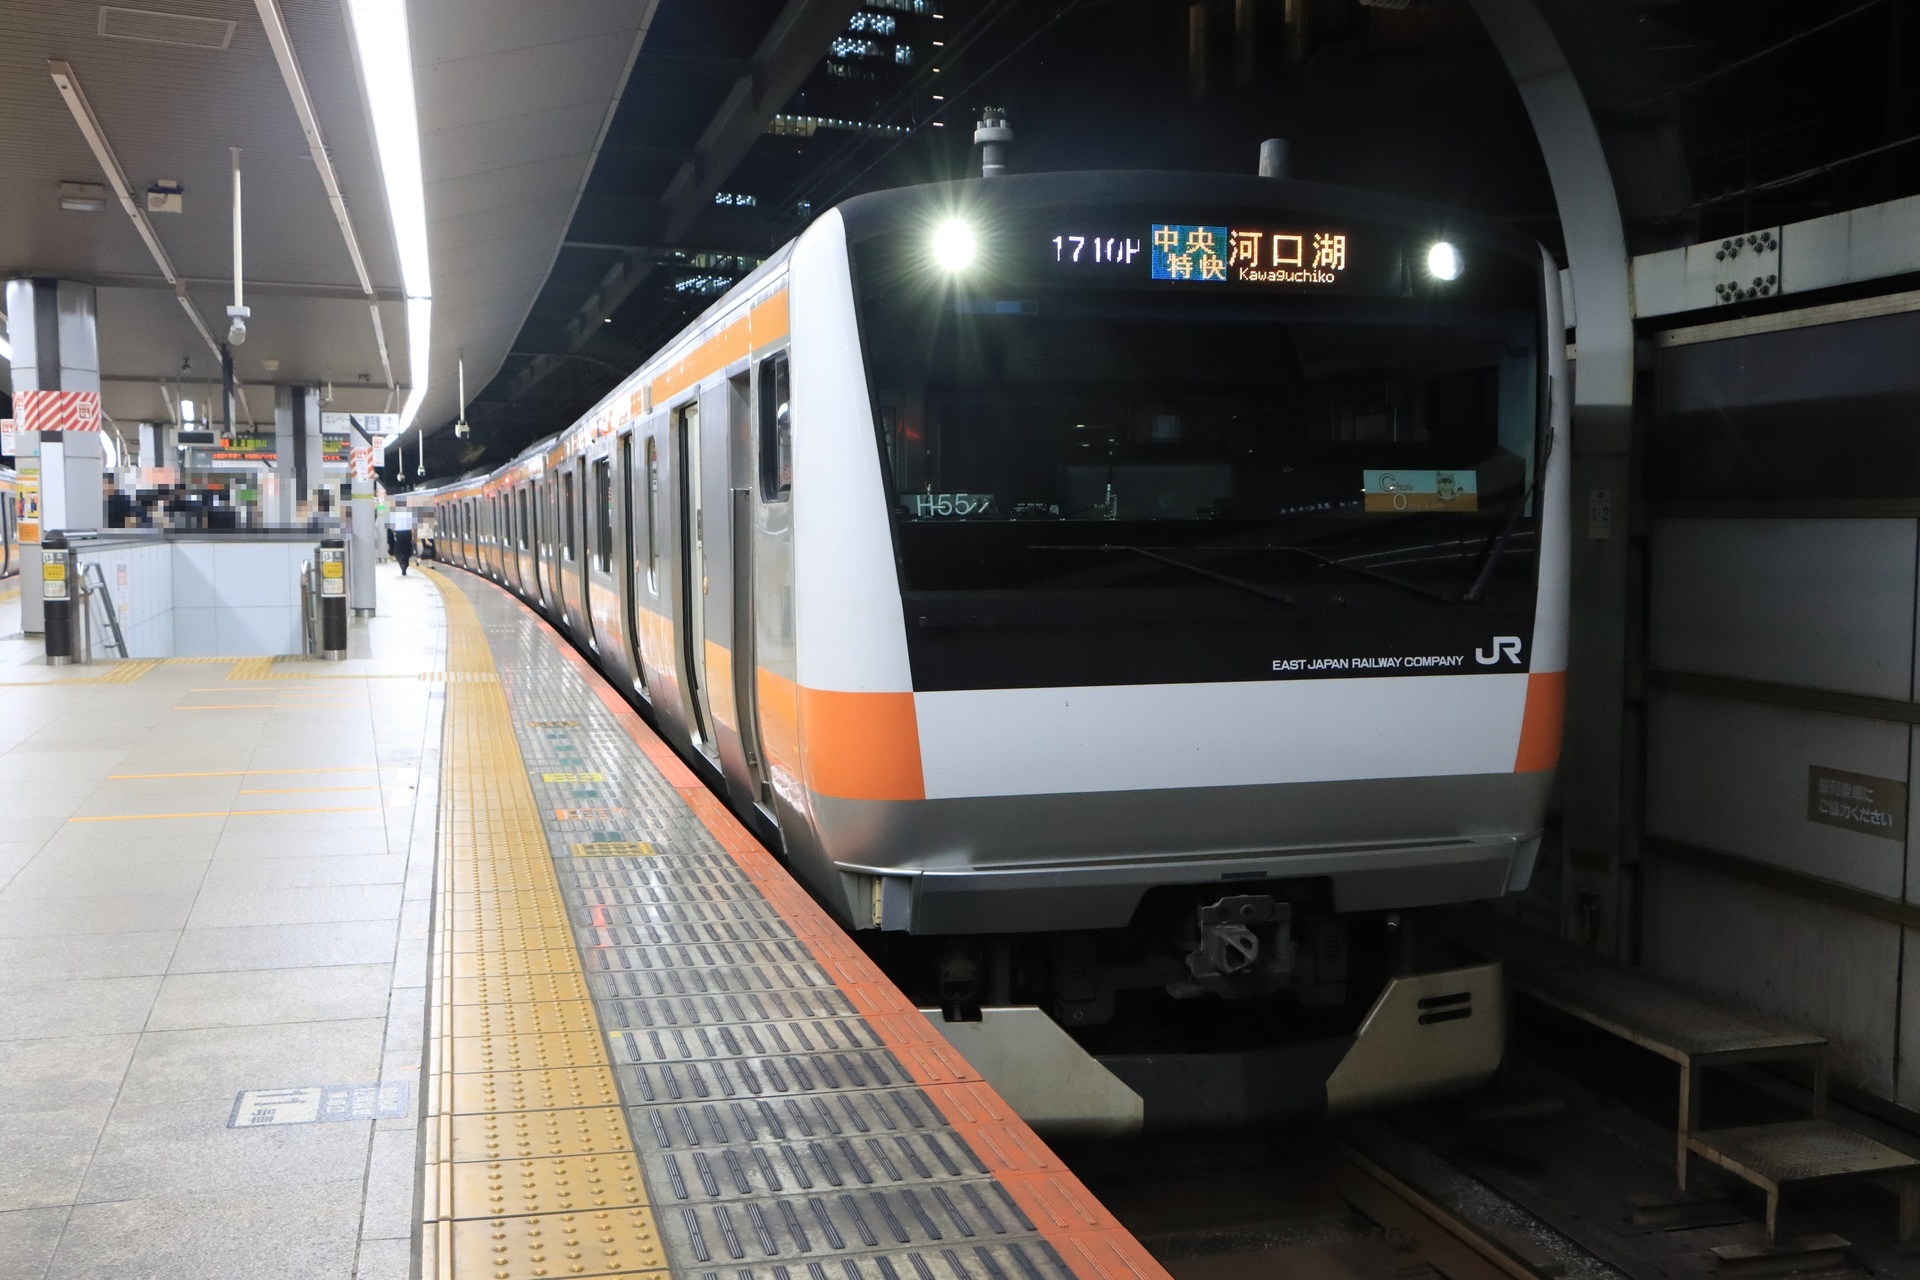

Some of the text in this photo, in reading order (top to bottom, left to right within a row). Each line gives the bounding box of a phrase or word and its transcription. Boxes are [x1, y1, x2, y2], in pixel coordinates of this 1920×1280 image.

[1154, 224, 1215, 254] 中央
[1228, 229, 1346, 270] 河口湖
[1166, 253, 1226, 280] 特快
[1239, 267, 1335, 284] Kawaguchiko
[1272, 655, 1464, 671] EAST JAPAN RAILWAY COMPANY
[1475, 635, 1522, 665] JR
[1818, 798, 1893, 827] ご協力ください
